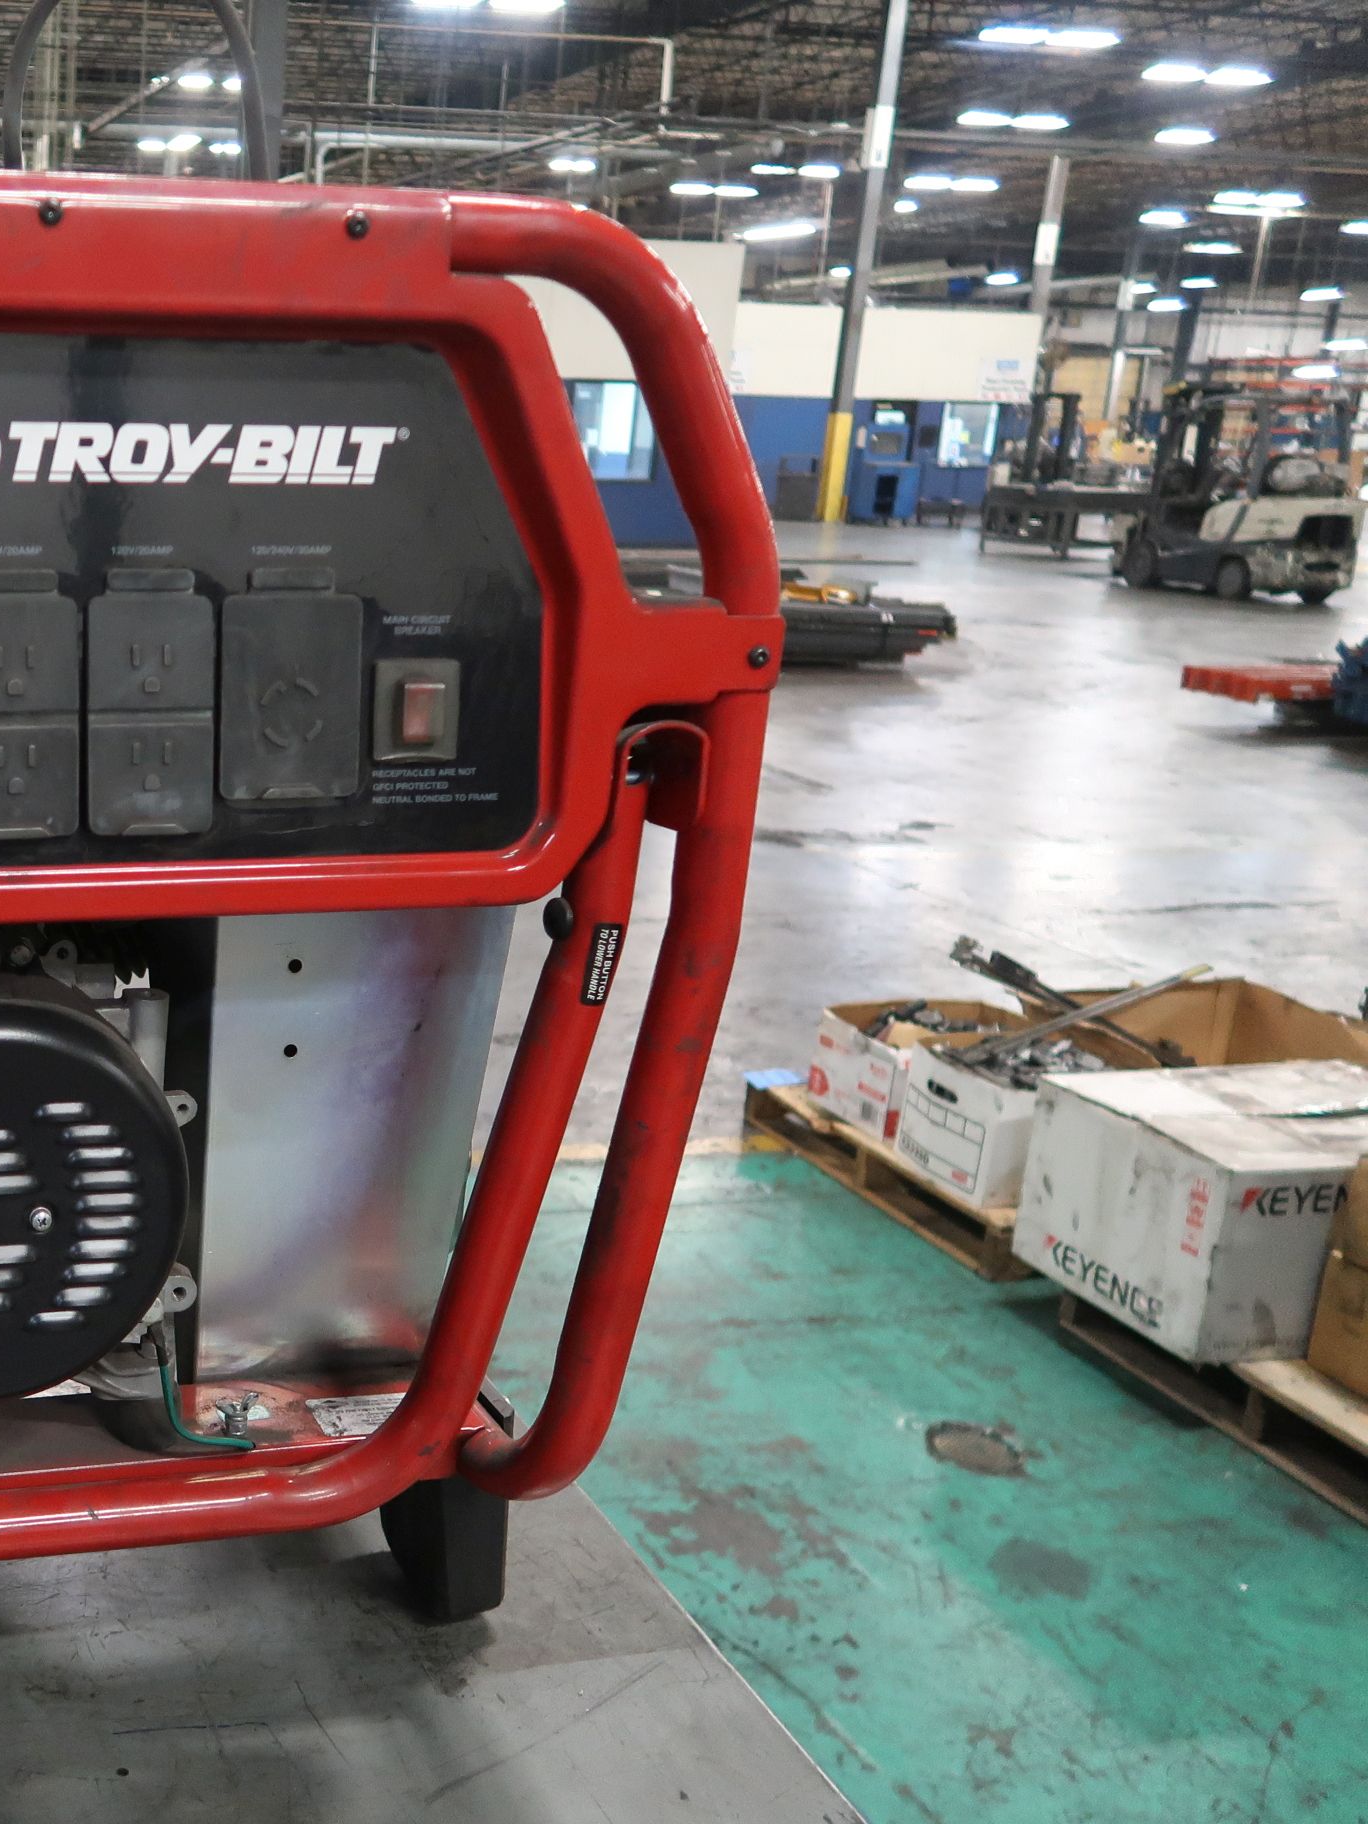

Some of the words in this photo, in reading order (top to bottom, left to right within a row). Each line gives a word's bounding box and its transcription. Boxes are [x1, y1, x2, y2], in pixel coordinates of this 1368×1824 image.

[382, 615, 408, 625] MAIN
[411, 614, 451, 625] CIRCUIT
[393, 625, 442, 635] BREAKER
[372, 768, 436, 778] RECEPTACLES
[438, 768, 457, 777] ARE
[458, 767, 477, 776] NOT
[372, 782, 395, 791] GFCI
[396, 781, 449, 791] PROTECTED
[372, 795, 414, 805] NEUTRAL
[415, 794, 454, 803] BONDED
[455, 793, 467, 802] TO
[468, 792, 499, 801] FRAME
[600, 929, 609, 939] TO
[606, 929, 619, 958] PUSH
[593, 939, 607, 968] LOWER
[587, 967, 602, 1000] HANDLE
[596, 960, 612, 1000] BUTTON
[1043, 1233, 1164, 1329] KEYENCE
